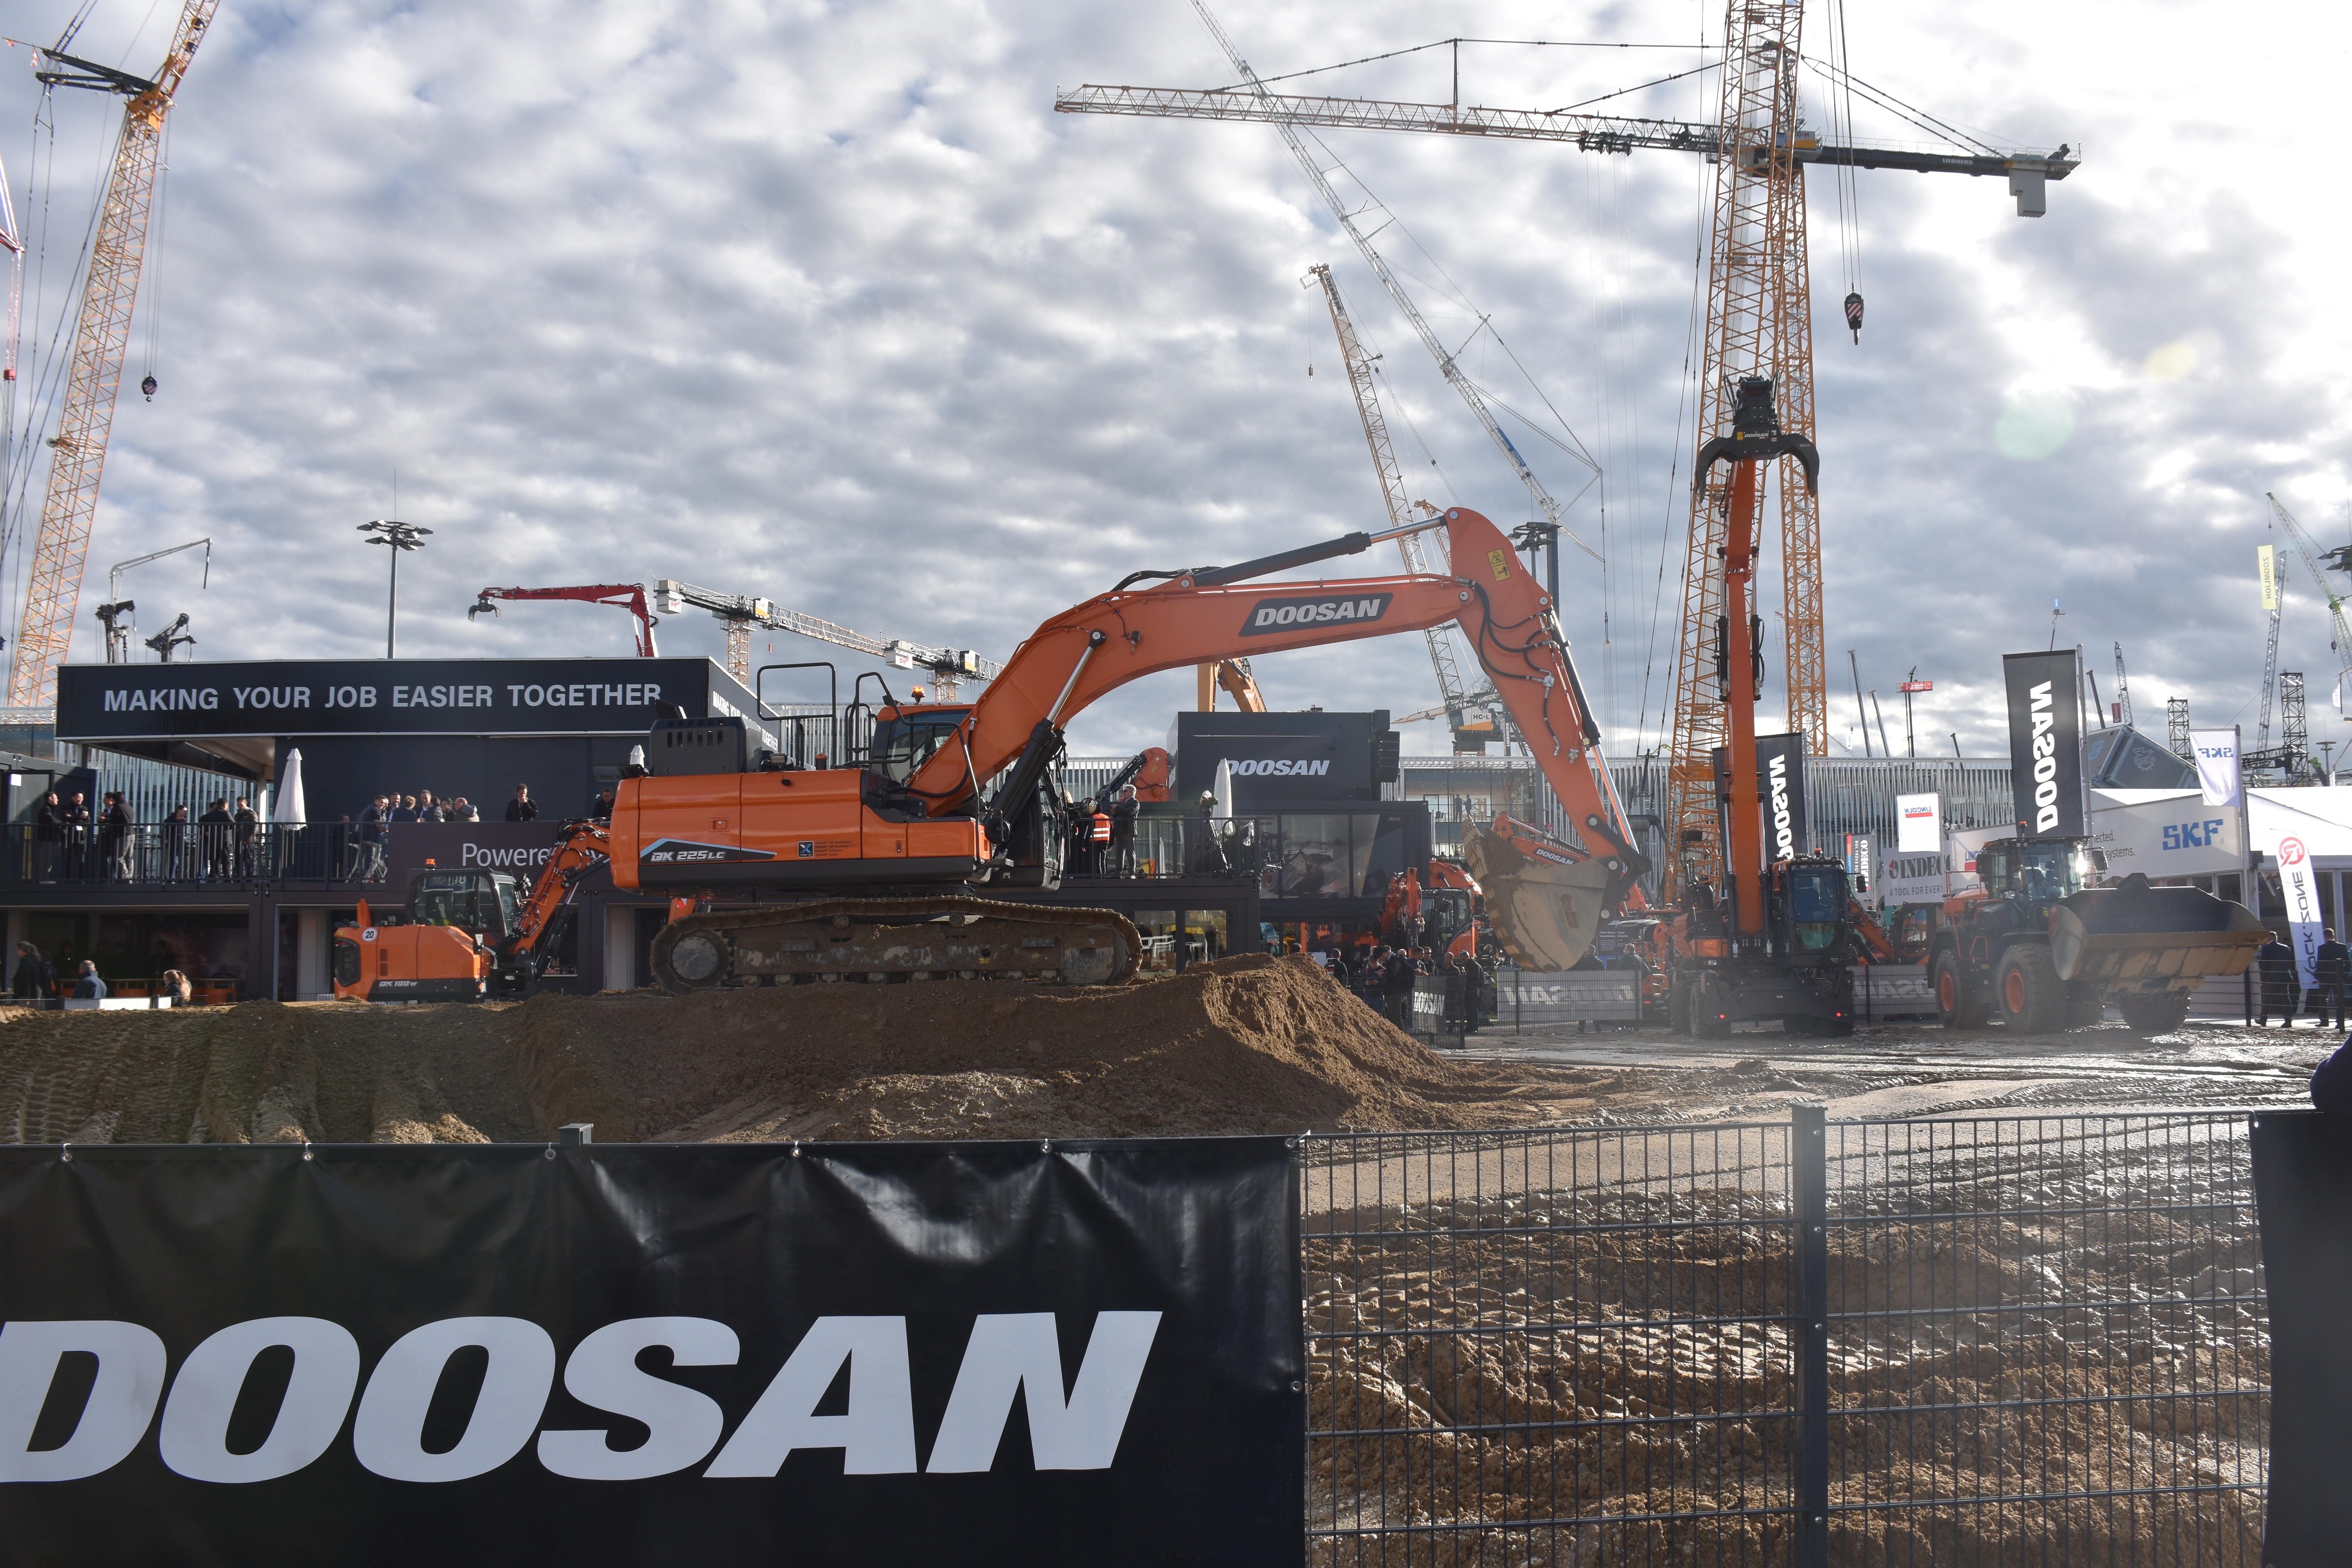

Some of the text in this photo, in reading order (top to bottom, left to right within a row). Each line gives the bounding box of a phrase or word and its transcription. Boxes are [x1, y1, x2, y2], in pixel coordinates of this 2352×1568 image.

[1254, 599, 1381, 627] DOOSAN
[104, 684, 661, 711] MAKING YOUR JOB EASIER TOGETHER
[713, 691, 730, 717] MAKING
[762, 728, 778, 752] TOGETHER
[1227, 760, 1330, 776] DOOSAN
[2162, 818, 2223, 851] SKF
[462, 843, 552, 866] Powere
[650, 851, 675, 862] DX
[1535, 849, 1573, 865] DOOSAN
[1965, 850, 1983, 862] LINC
[2105, 847, 2135, 861] systems.
[1895, 888, 1910, 896] TOOL
[1912, 886, 1924, 895] FOR
[365, 930, 374, 938] 20
[1414, 991, 1445, 1016] DOOSAN
[0, 1310, 1164, 1483] DOOSAN
